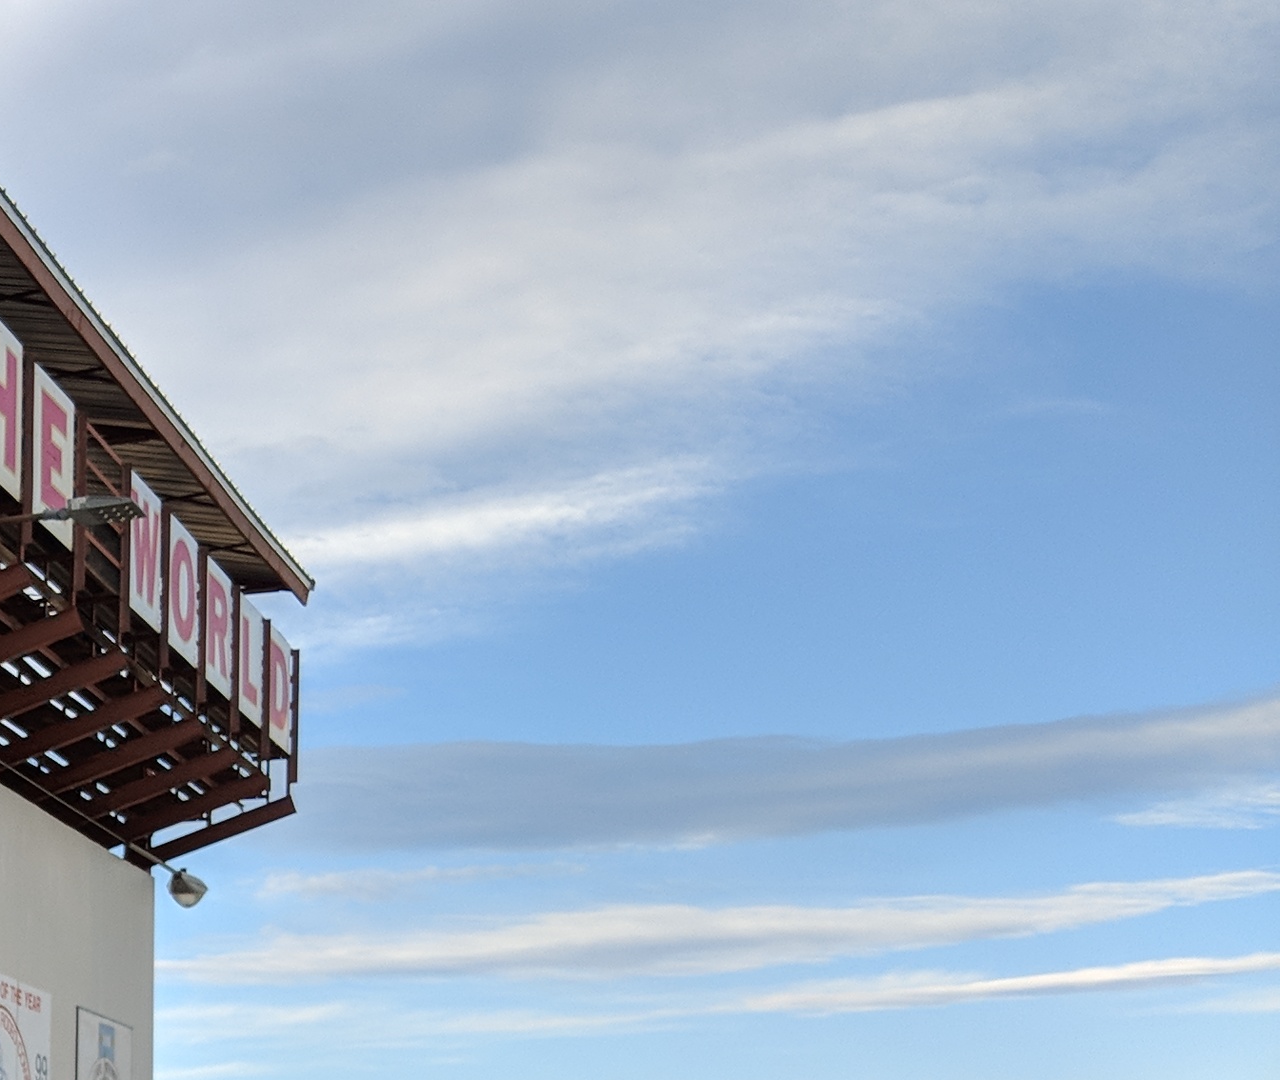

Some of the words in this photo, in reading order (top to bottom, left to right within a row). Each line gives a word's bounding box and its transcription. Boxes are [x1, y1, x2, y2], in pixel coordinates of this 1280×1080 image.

[131, 492, 290, 730] WORLD
[0, 981, 9, 999] OF
[10, 985, 22, 1006] THE
[25, 992, 42, 1013] YEAR
